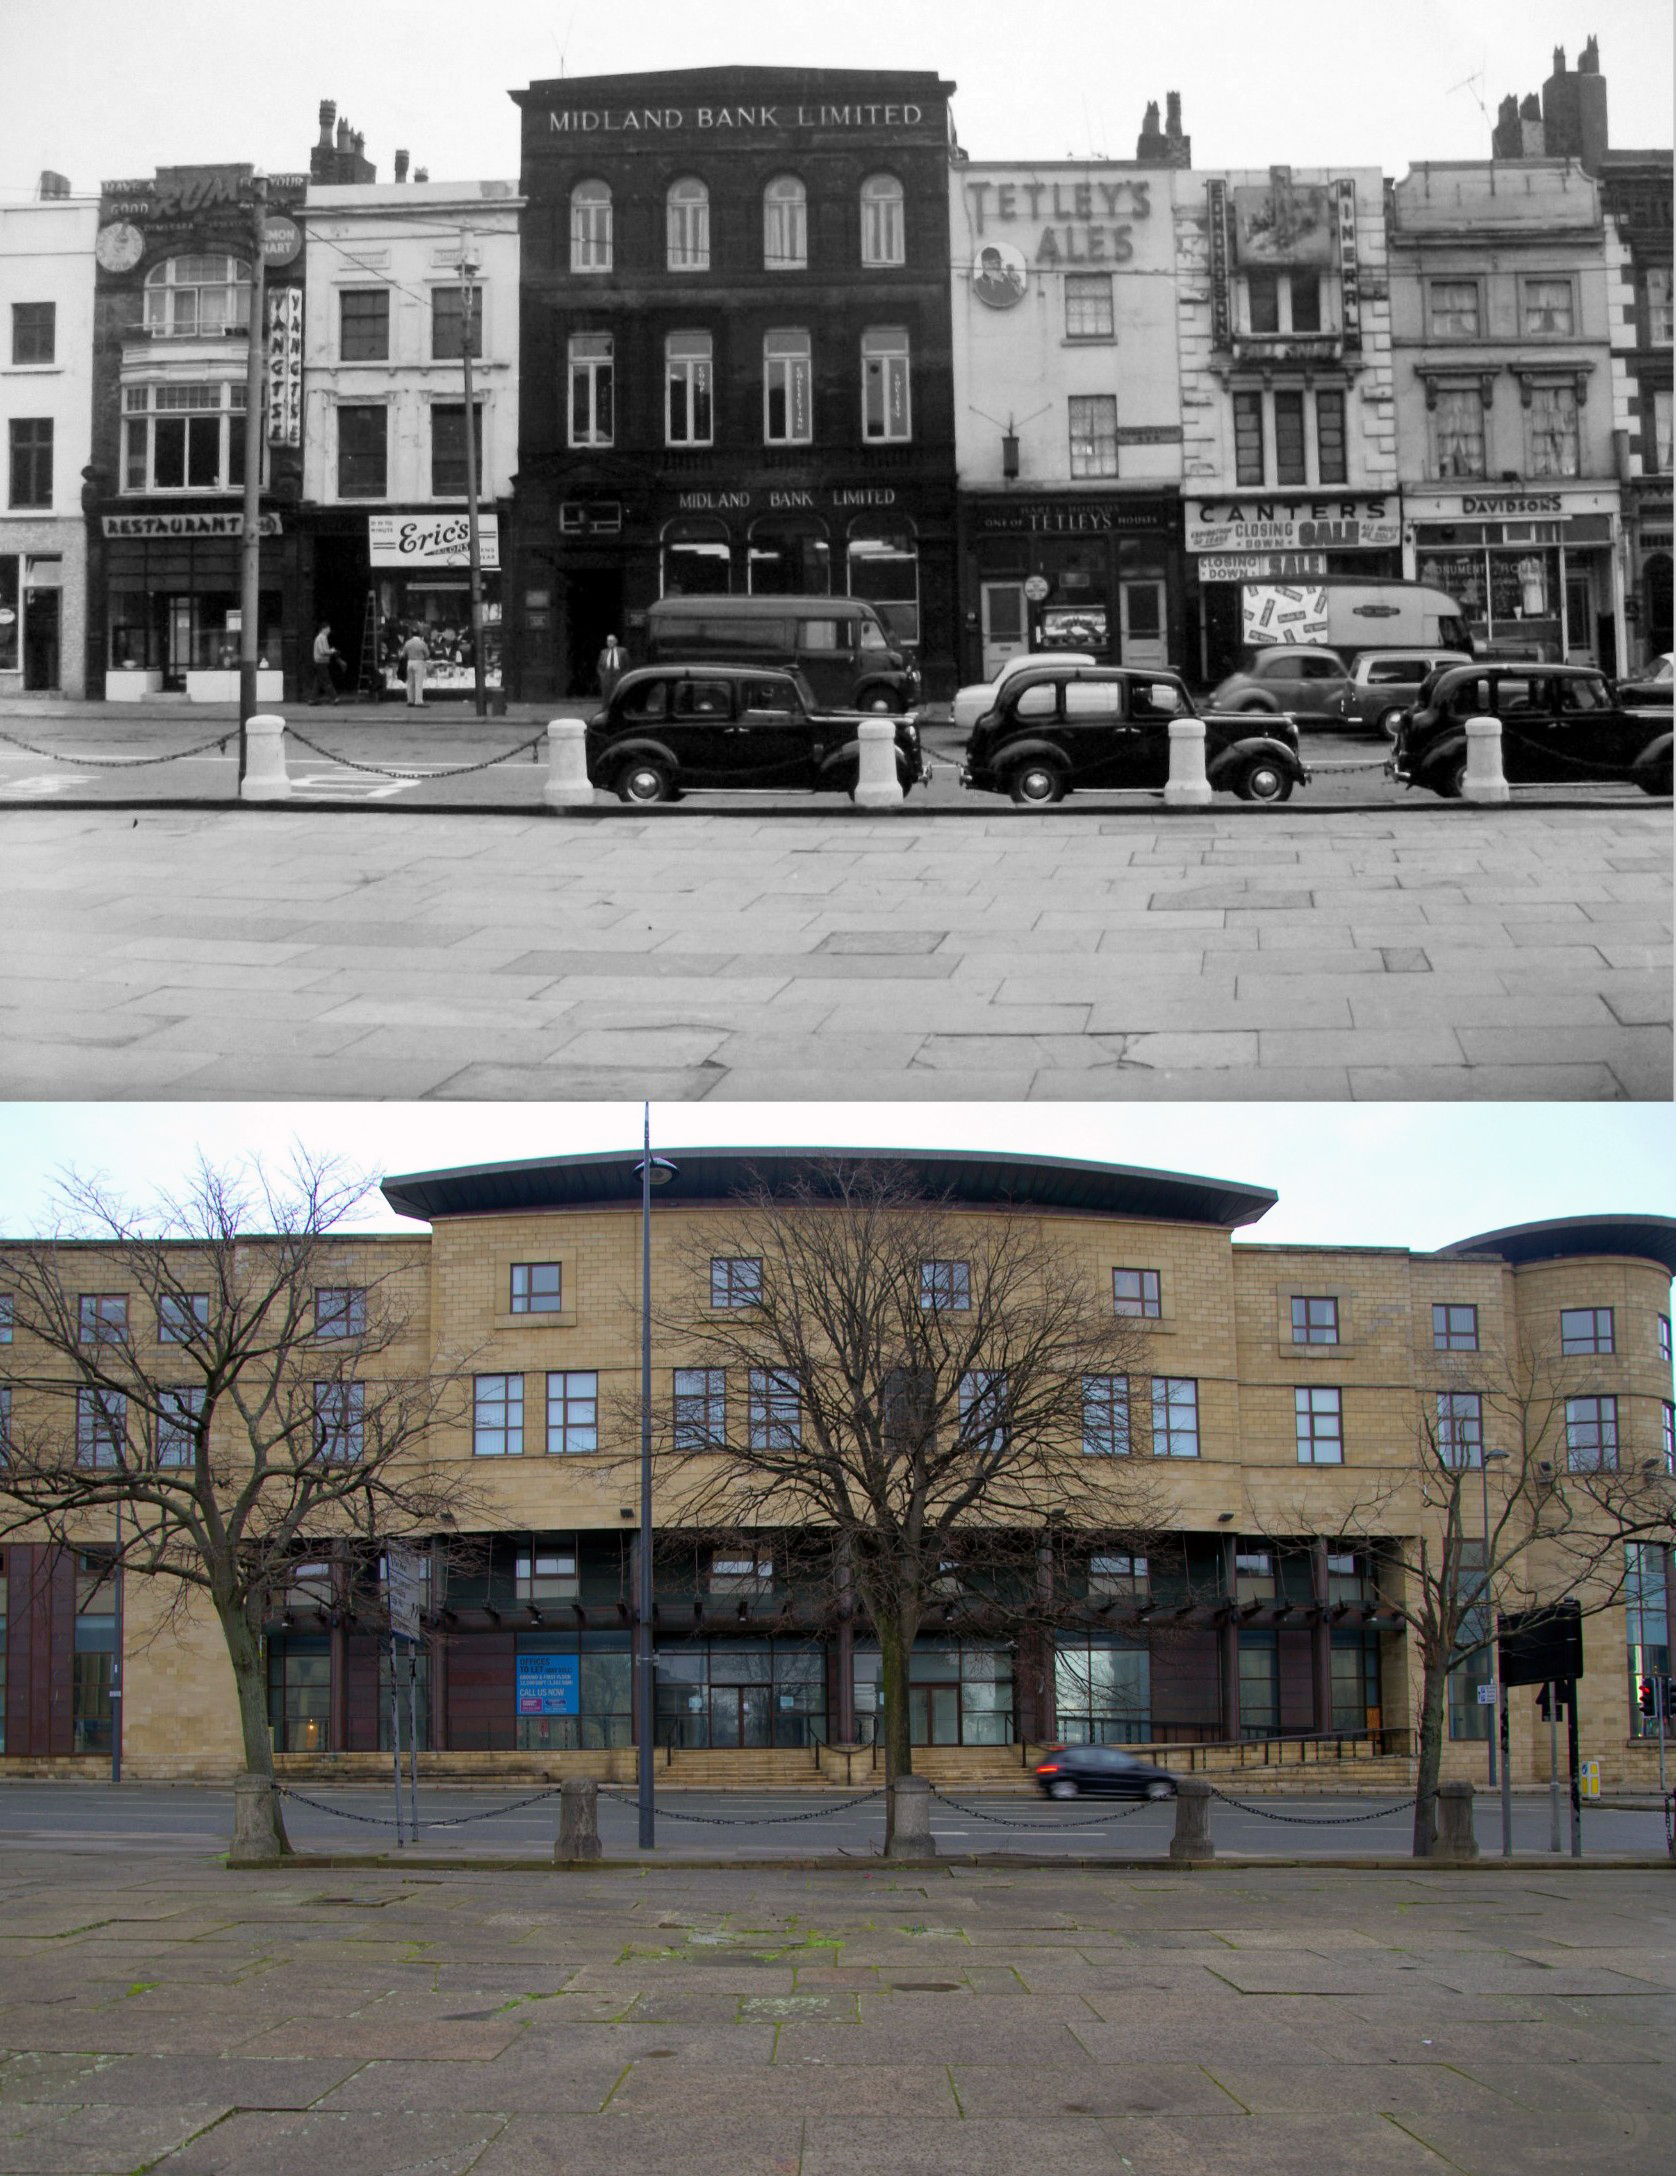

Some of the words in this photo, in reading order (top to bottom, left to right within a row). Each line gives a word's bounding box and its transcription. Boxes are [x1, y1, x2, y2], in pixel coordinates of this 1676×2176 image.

[550, 109, 683, 131] MIDLAND
[697, 107, 778, 128] BANK
[798, 105, 922, 126] LIMITED
[269, 177, 304, 188] YOUR
[151, 177, 239, 219] RUM
[110, 203, 149, 215] GOOD
[264, 229, 295, 241] EMON
[1035, 224, 1133, 263] ALES
[1340, 183, 1361, 351] MINERALS
[271, 296, 285, 441] YANGTSE
[290, 295, 301, 442] YANGTSE
[679, 492, 750, 509] MIDLAND
[770, 491, 814, 507] BANK
[833, 488, 895, 505] LIMITED
[1435, 501, 1440, 510] 4
[1592, 497, 1598, 505] 4
[1199, 501, 1386, 523] CANTERS
[107, 517, 241, 535] RESTAURANT
[985, 519, 1007, 527] ONE
[1010, 518, 1022, 526] OF
[1235, 521, 1293, 538] CLOSING
[398, 520, 470, 553] Eric's
[1246, 539, 1285, 548] DOWN
[1200, 556, 1257, 568] CLOSING
[1269, 556, 1320, 575] SALE
[1209, 567, 1249, 579] DOWN
[520, 1657, 550, 1666] OFFICES
[520, 1688, 536, 1697] CALL
[538, 1688, 547, 1696] US
[548, 1688, 564, 1696] NOW
